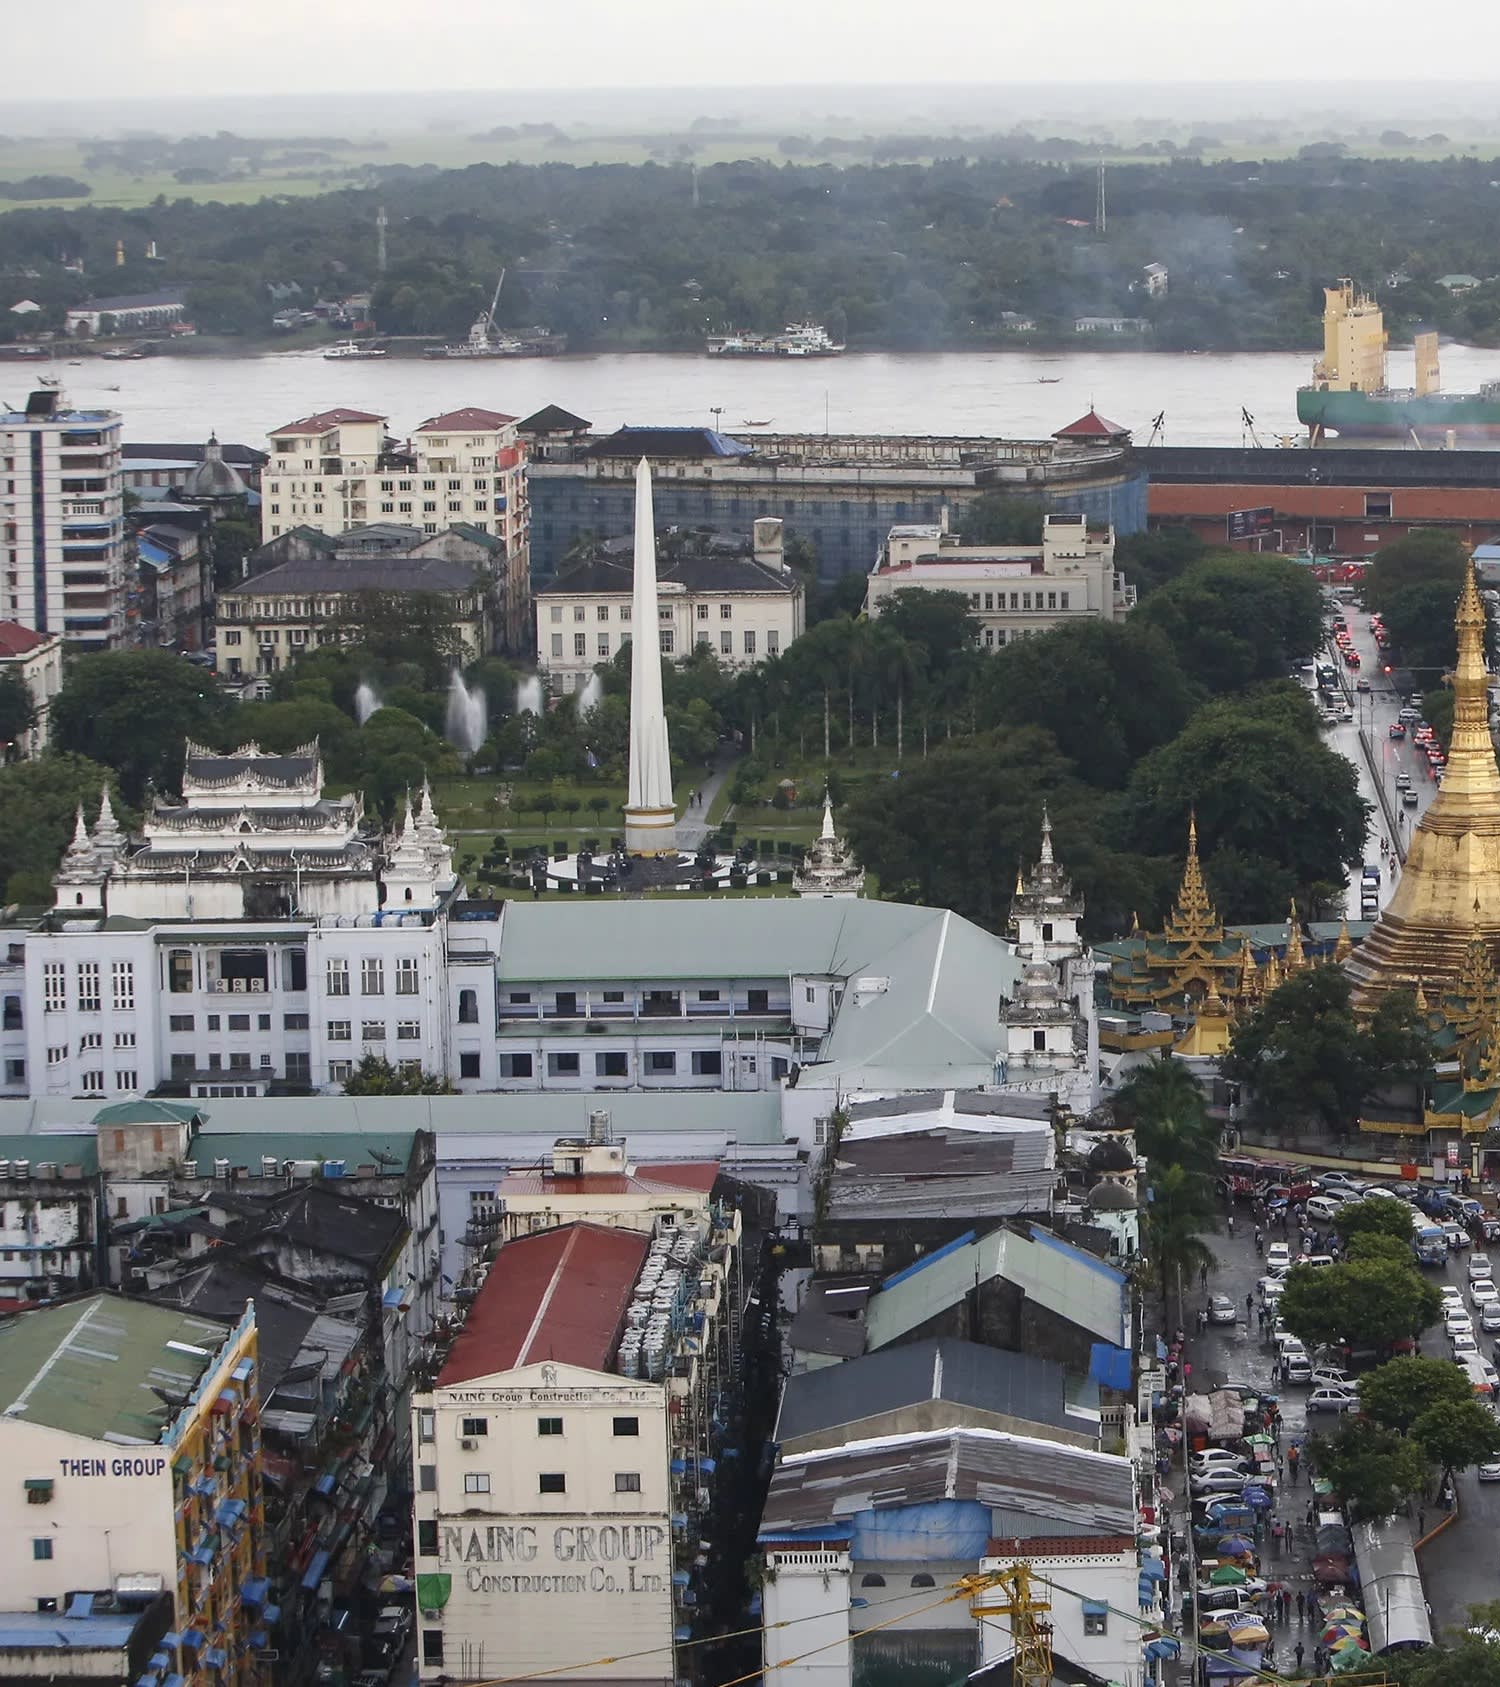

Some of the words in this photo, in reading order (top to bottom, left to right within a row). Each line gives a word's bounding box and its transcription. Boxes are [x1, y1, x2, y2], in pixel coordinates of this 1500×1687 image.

[449, 1392, 485, 1402] NAING
[492, 1392, 523, 1403] Group
[60, 1459, 106, 1476] THEIN
[112, 1459, 165, 1476] GROUP
[443, 1526, 538, 1562] NAING
[553, 1525, 665, 1562] GROUP
[466, 1566, 585, 1593] CONSTRUCTION
